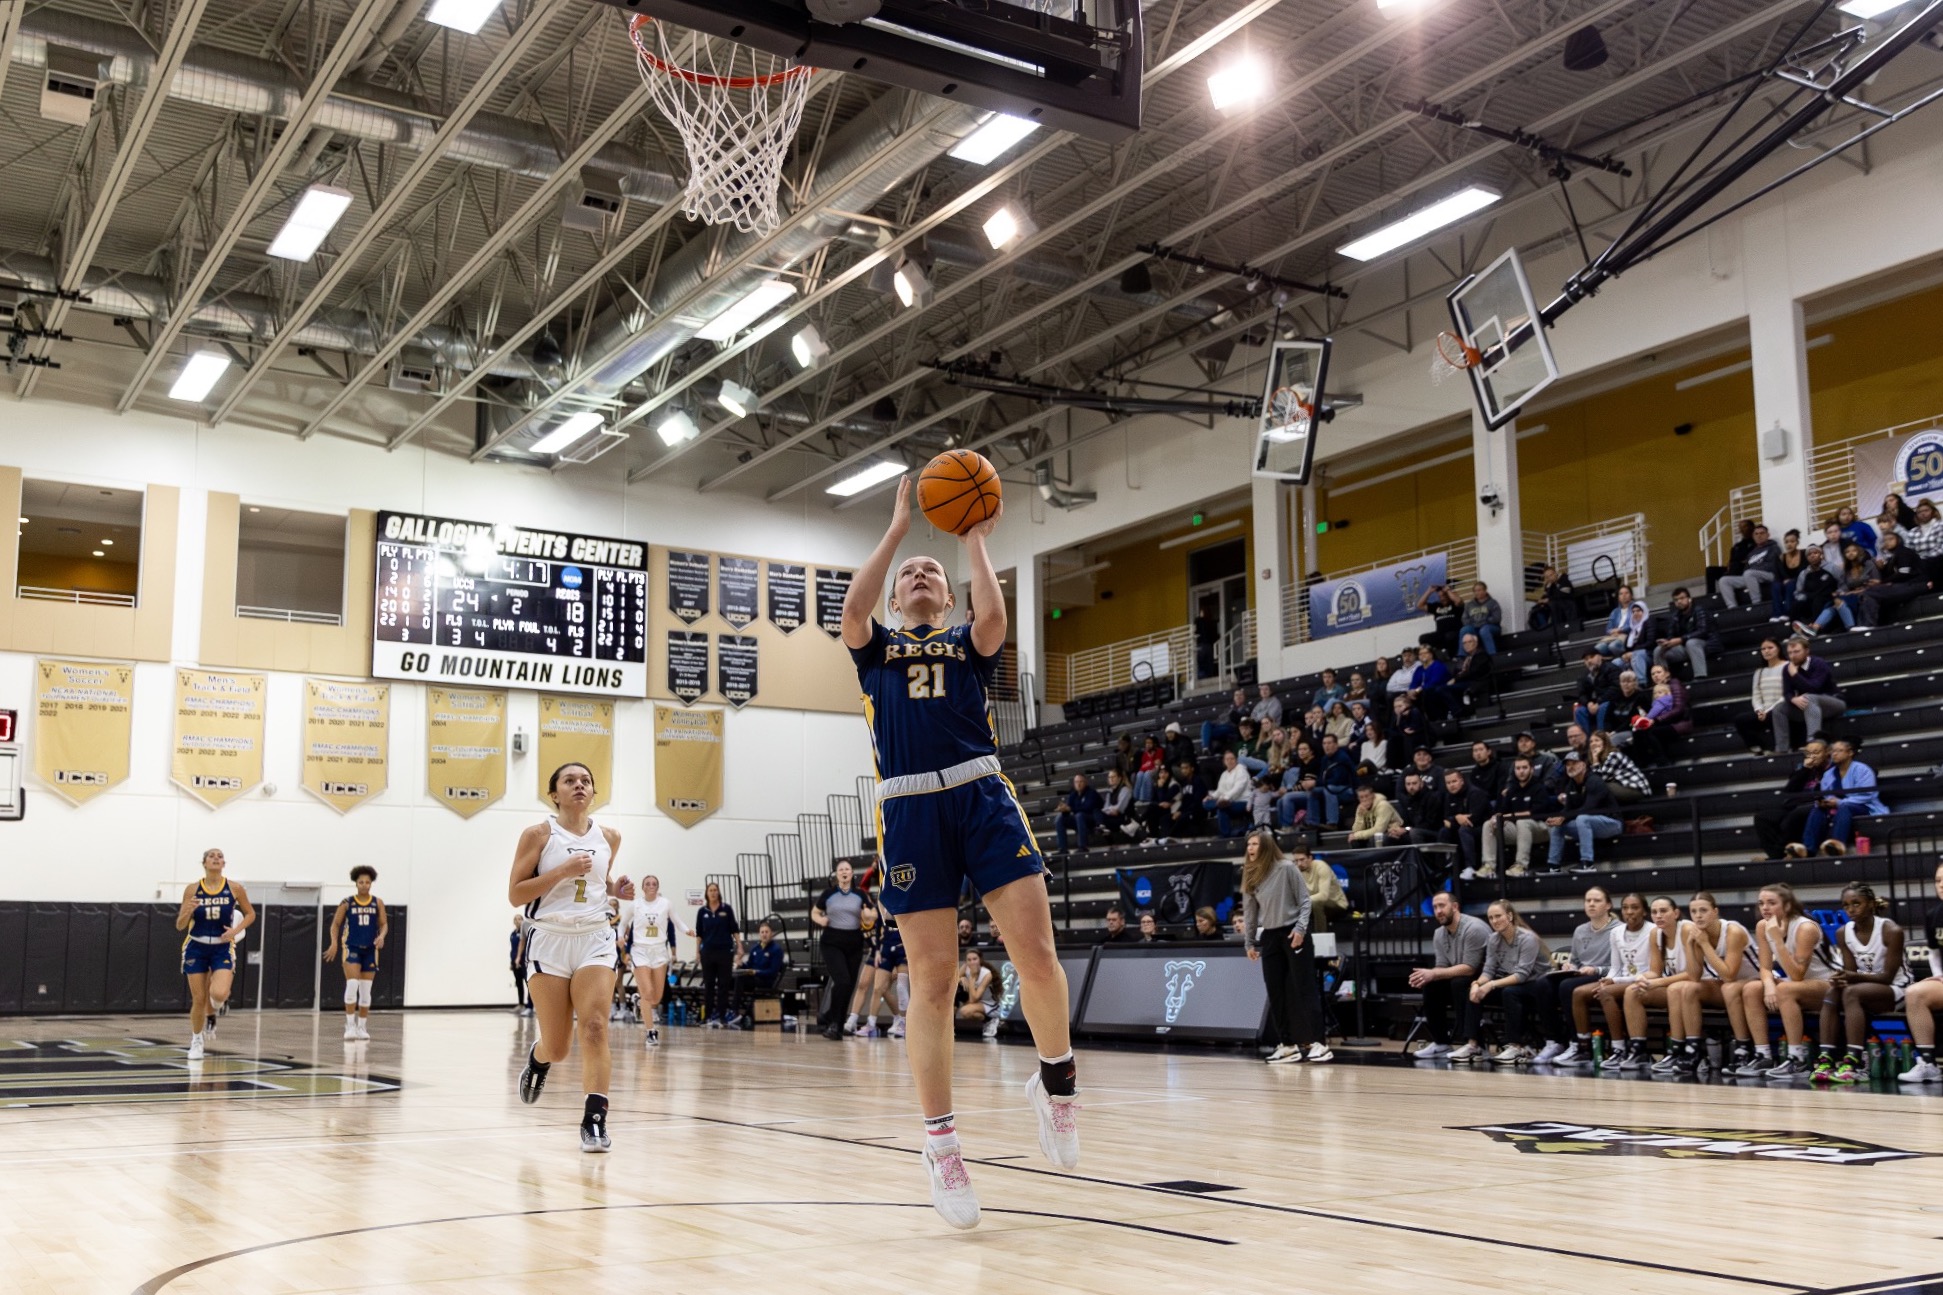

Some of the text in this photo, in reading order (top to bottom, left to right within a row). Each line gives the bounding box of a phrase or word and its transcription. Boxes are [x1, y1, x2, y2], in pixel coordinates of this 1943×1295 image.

[1910, 451, 1943, 481] 50
[381, 545, 398, 557] PLY
[402, 547, 413, 559] FL
[570, 537, 643, 567] CENTER
[391, 558, 398, 570] 0
[503, 560, 547, 582] 4:17
[390, 572, 398, 584] 2
[424, 575, 431, 587] 6
[453, 576, 475, 590] UCCS
[598, 569, 645, 584] PLY FL PTS
[385, 586, 431, 602] 14 0 2
[506, 588, 529, 598] PERIOD
[606, 582, 614, 593] 4
[636, 585, 644, 597] 6
[380, 599, 431, 615] 20 0 2
[452, 590, 479, 612] 24
[512, 598, 522, 614] 2
[602, 594, 614, 607] 10
[636, 598, 644, 608] 4
[566, 602, 584, 623] 18
[602, 608, 614, 620] 15
[635, 610, 643, 623] 0
[380, 612, 397, 626] 22
[422, 616, 431, 629] 0
[446, 614, 463, 627] FLS
[493, 619, 514, 632] PLYR
[518, 621, 540, 634] FOUL
[567, 625, 584, 638] FLS
[598, 620, 613, 632] 21
[635, 624, 643, 635] 4
[823, 622, 841, 632] UCC
[402, 628, 409, 641] 3
[452, 629, 485, 646] 3 4
[598, 633, 613, 646] 22
[635, 636, 643, 649] 0
[546, 638, 583, 655] 4 2
[616, 647, 624, 660] 2
[884, 641, 966, 664] REGIS
[63, 667, 109, 676] Women's
[400, 652, 623, 688] GO MOUNTAIN LIONS
[69, 676, 102, 684] Soccer
[194, 683, 216, 691] Track
[907, 662, 946, 699] 21
[675, 687, 701, 697] UCCS
[726, 690, 750, 699] UCCS
[54, 770, 108, 785] UCCS
[191, 775, 242, 791] UCCS
[321, 781, 368, 796] UCCS
[445, 787, 489, 800] UCCS
[668, 798, 708, 811] UCCS
[892, 870, 915, 884] RU
[198, 896, 230, 906] REGIS
[205, 906, 221, 920] 15
[358, 914, 370, 926] 10
